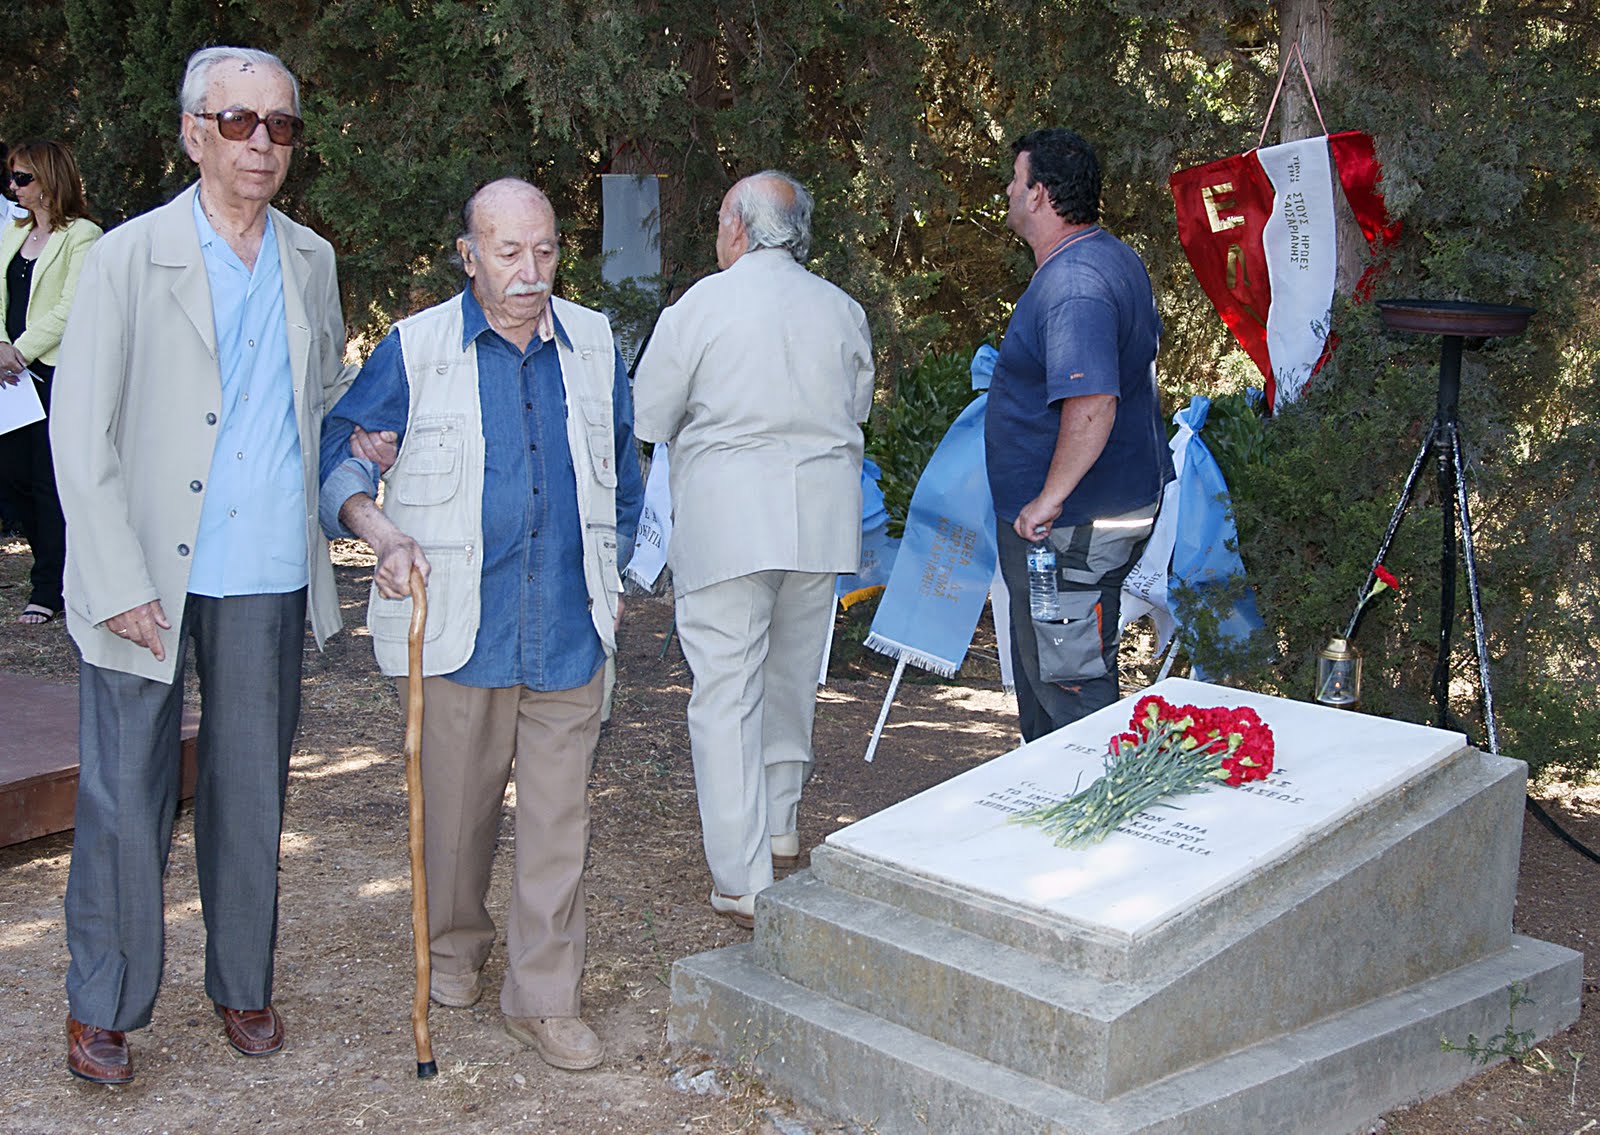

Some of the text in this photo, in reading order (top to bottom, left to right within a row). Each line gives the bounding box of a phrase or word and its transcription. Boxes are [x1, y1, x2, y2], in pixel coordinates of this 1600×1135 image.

[1293, 192, 1309, 225] ΣΤΟΥΣ
[1284, 194, 1300, 263] ΚΑΙΣΑΡΙΑΝΗΣ
[1299, 235, 1310, 271] ΗΡΩΕΣ
[1141, 571, 1163, 599] ΙΑΝΗΣ
[1063, 743, 1305, 804] ΤΗΣ ΑΣΕΩΣ
[974, 799, 1023, 813] ΛΕΙΠΕΤ
[987, 792, 1012, 801] ΚΑΙ
[1114, 826, 1175, 846] ΜΝΗΣΤΟΣ
[1137, 811, 1166, 823] ΤΩΝ
[1172, 821, 1208, 834] ΠΑΡΑ
[1130, 820, 1156, 831] ΚΑΙ
[1159, 829, 1206, 843] ΛΟΓΟΥ
